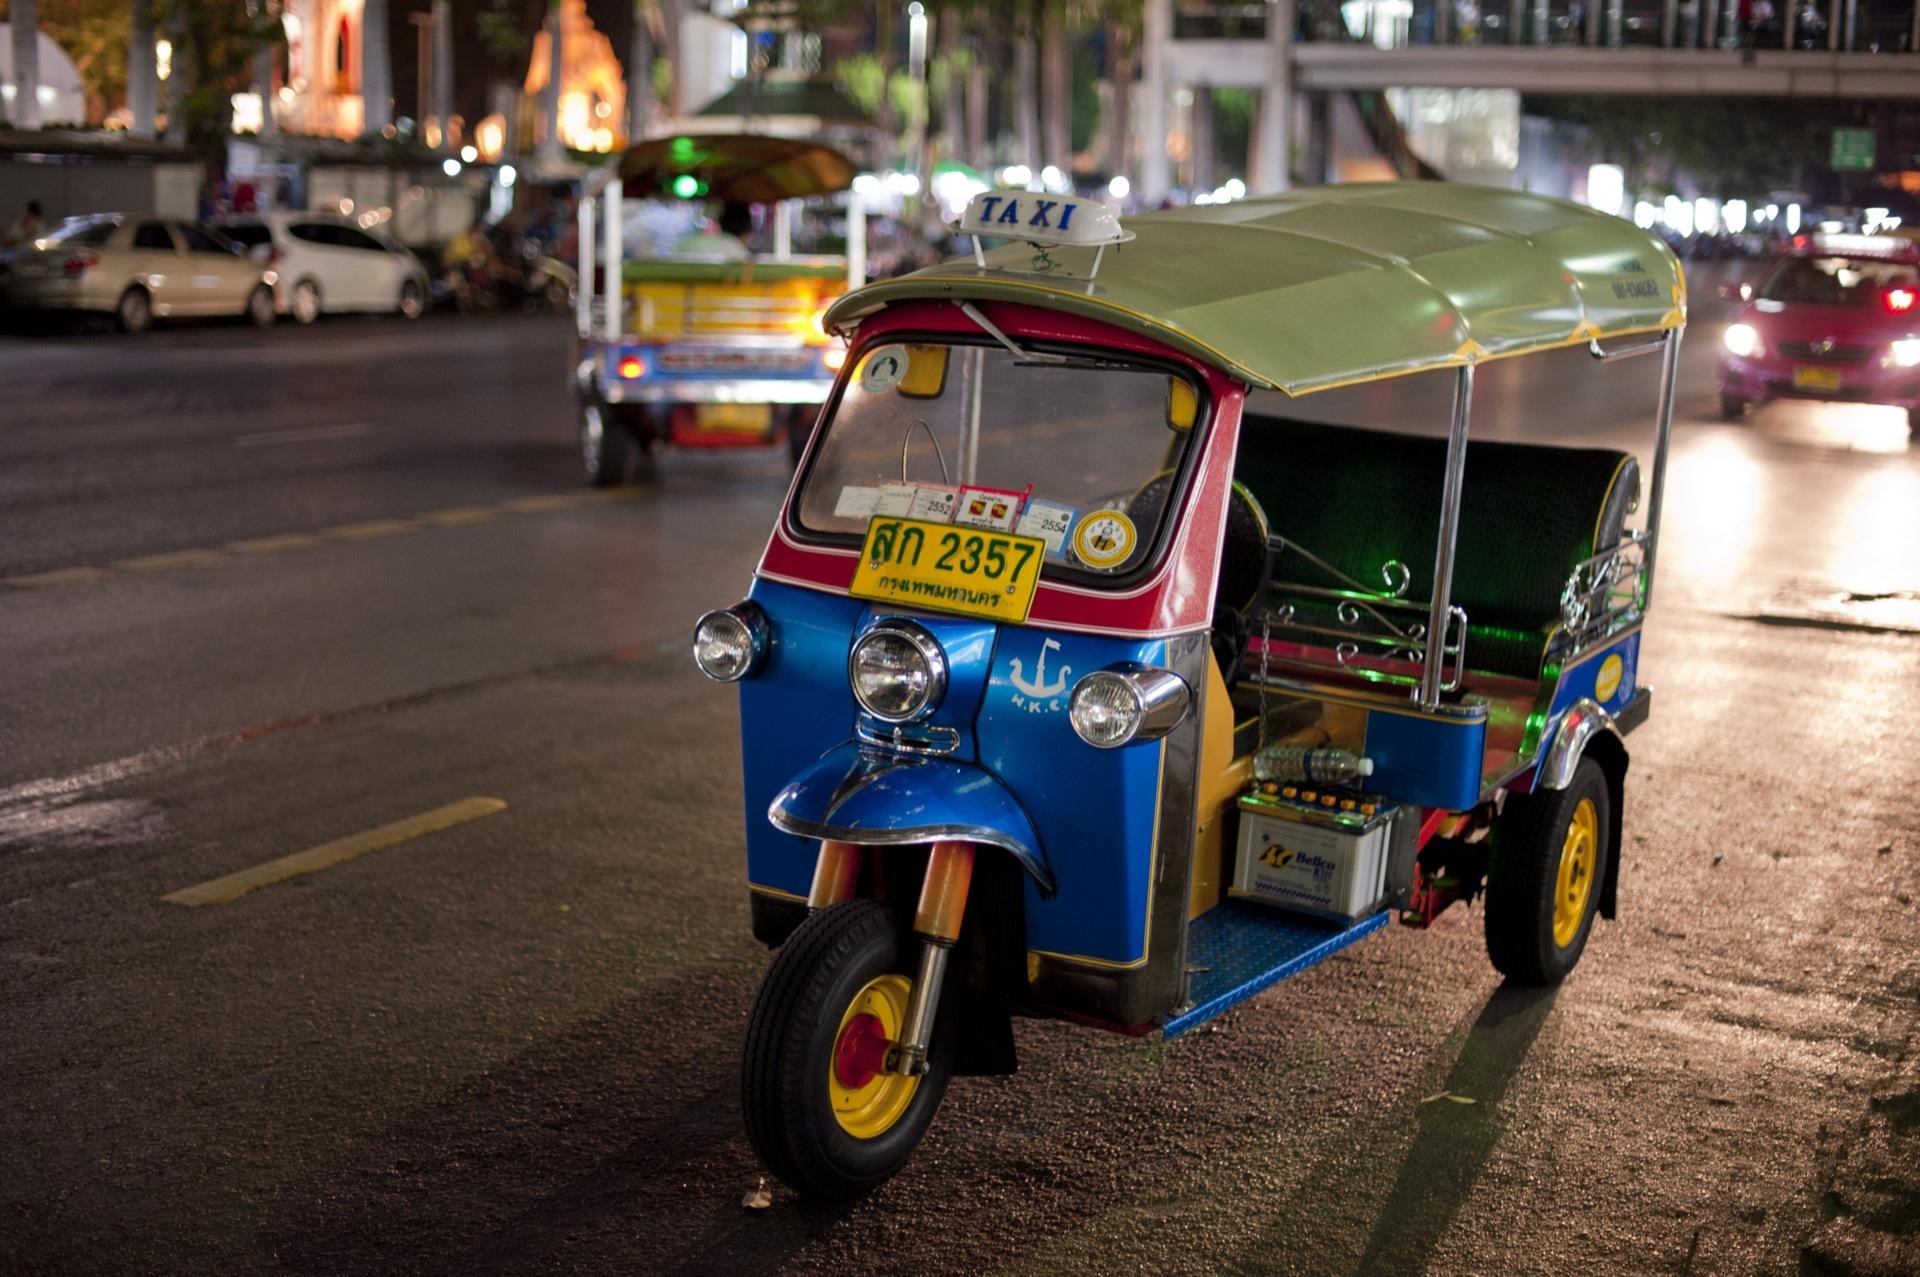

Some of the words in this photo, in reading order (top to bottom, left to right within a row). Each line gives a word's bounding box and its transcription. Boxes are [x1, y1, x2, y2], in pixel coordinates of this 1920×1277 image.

[980, 196, 1077, 230] TAXI
[927, 500, 951, 515] 2552
[1041, 518, 1067, 534] 2554
[870, 521, 926, 567] สก
[934, 531, 1036, 583] 2357
[877, 574, 1002, 608] กรุงเทพมหานคร
[1295, 851, 1336, 871] Bellco
